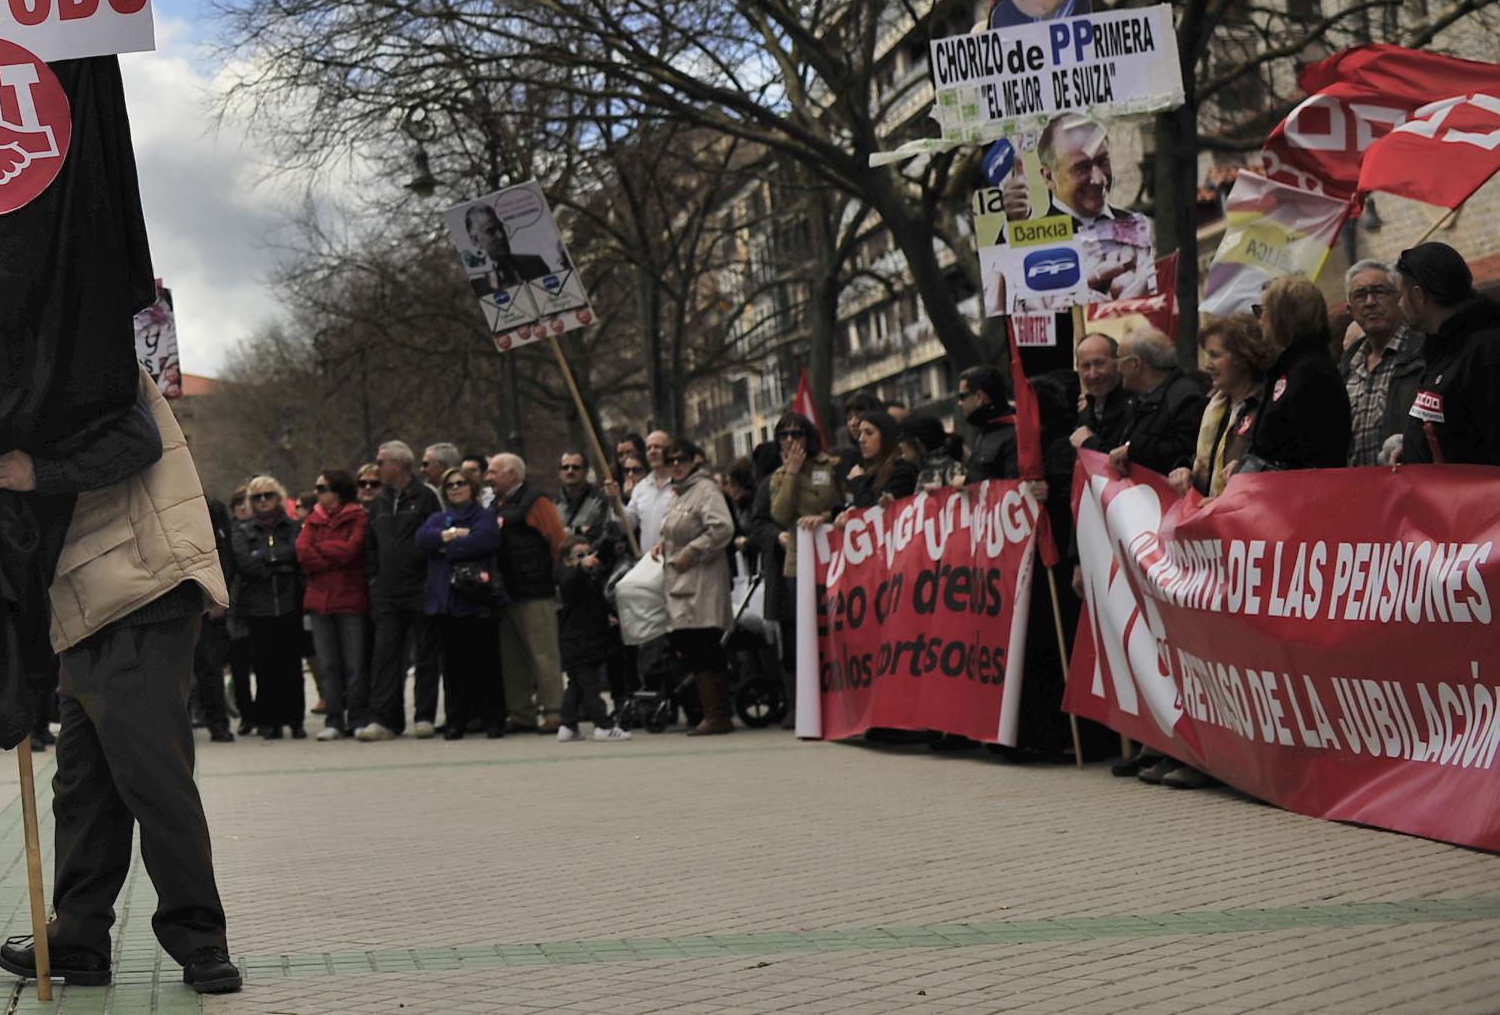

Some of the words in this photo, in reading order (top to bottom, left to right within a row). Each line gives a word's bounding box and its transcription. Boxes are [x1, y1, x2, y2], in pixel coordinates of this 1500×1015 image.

[936, 33, 1004, 84] CHORIZO
[1007, 40, 1045, 74] de
[1003, 76, 1044, 118] MEJOR
[1052, 69, 1072, 110] DE
[1014, 222, 1068, 243] Bankia
[1227, 540, 1267, 616] DE
[1268, 540, 1327, 621] LAS
[1328, 540, 1493, 625] PENSIONES
[1246, 668, 1295, 746] DE
[1284, 673, 1341, 750] LA
[1331, 660, 1500, 770] JUBILACIÓN
